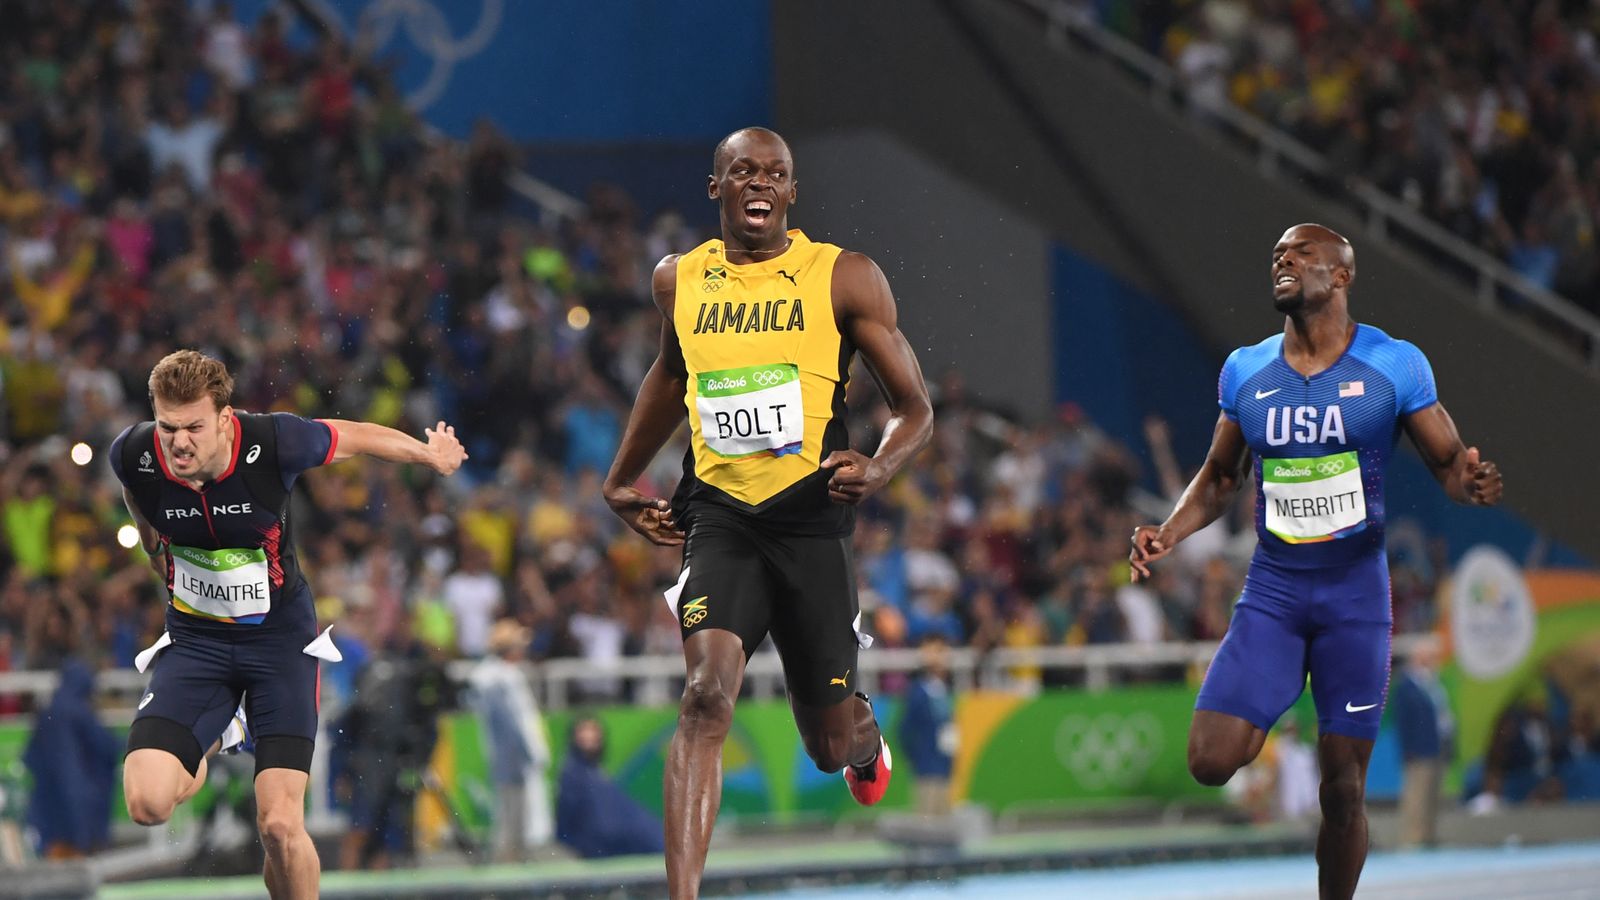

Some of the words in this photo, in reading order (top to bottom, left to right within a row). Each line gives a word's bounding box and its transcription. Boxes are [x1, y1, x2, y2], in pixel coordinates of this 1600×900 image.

[693, 299, 804, 334] JAMAICA
[715, 404, 786, 439] BOLT
[1266, 405, 1347, 446] USA
[165, 503, 252, 519] FRANCE
[1275, 491, 1357, 517] MERRITT
[182, 573, 265, 601] LEMAITRE
